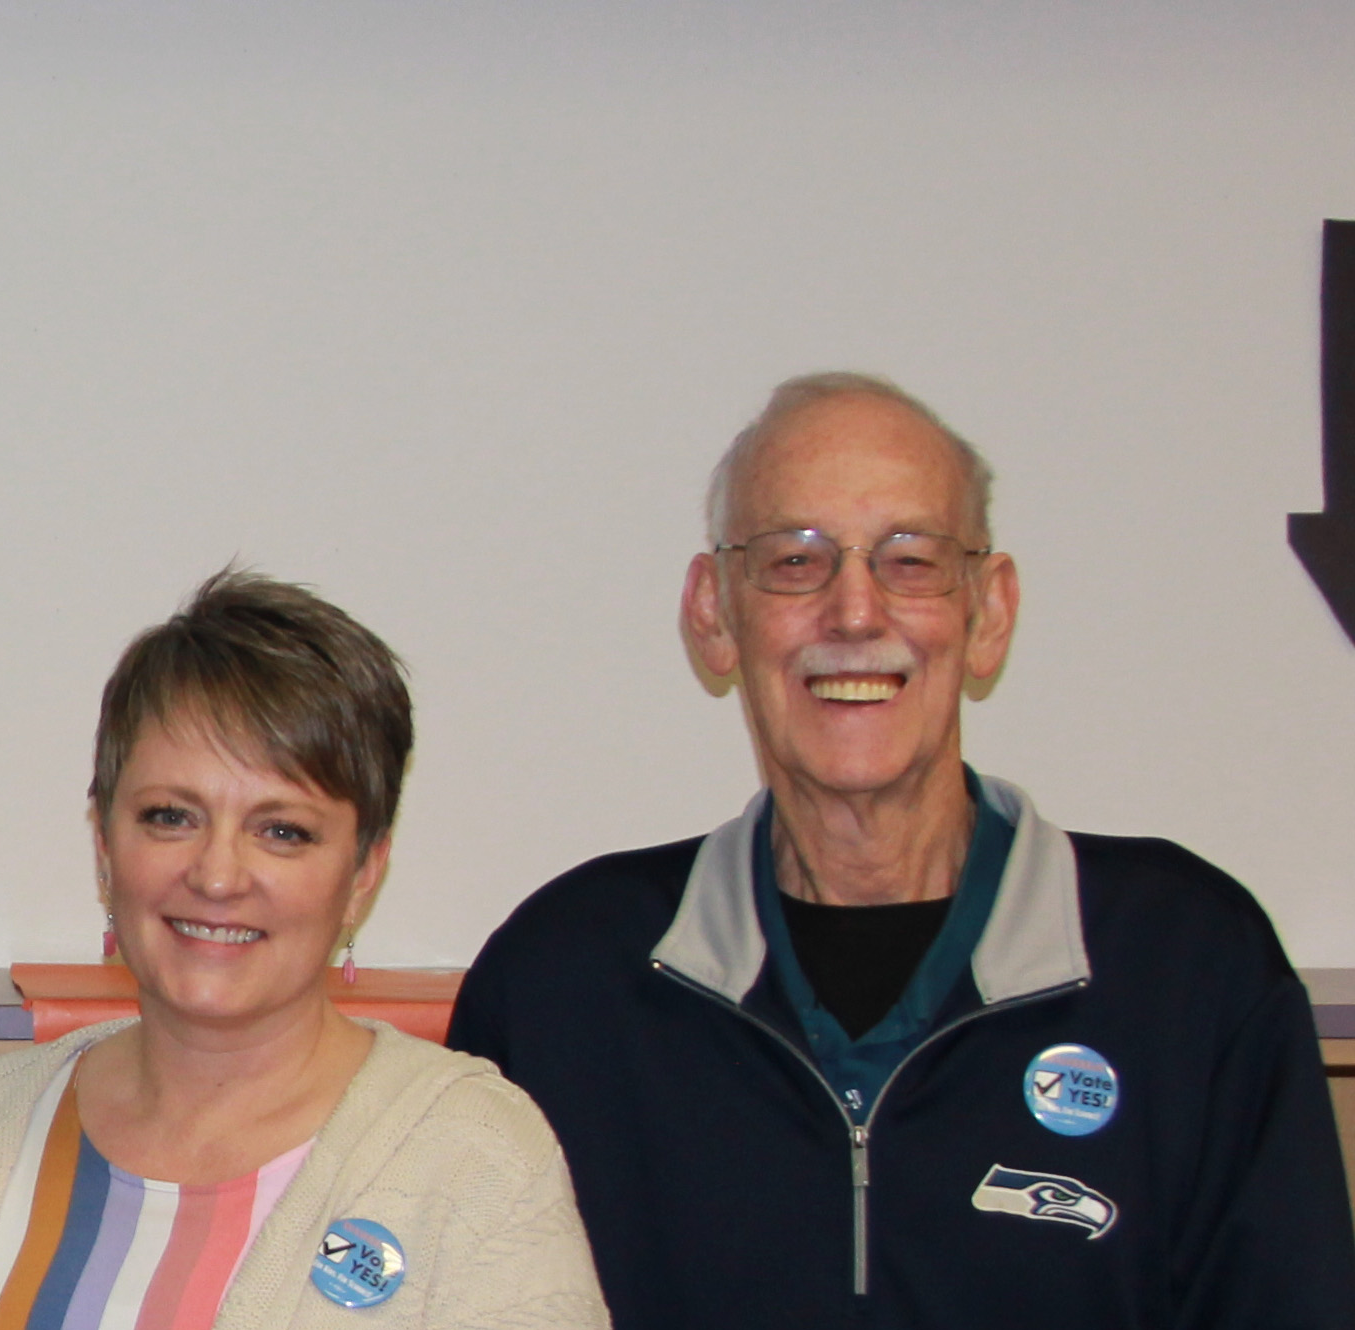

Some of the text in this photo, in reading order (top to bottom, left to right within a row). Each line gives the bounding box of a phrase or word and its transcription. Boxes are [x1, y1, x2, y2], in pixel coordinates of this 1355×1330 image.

[1070, 1070, 1113, 1090] Vote
[1068, 1088, 1109, 1108] YES!
[360, 1244, 382, 1268] Vo
[349, 1259, 388, 1291] YES!
